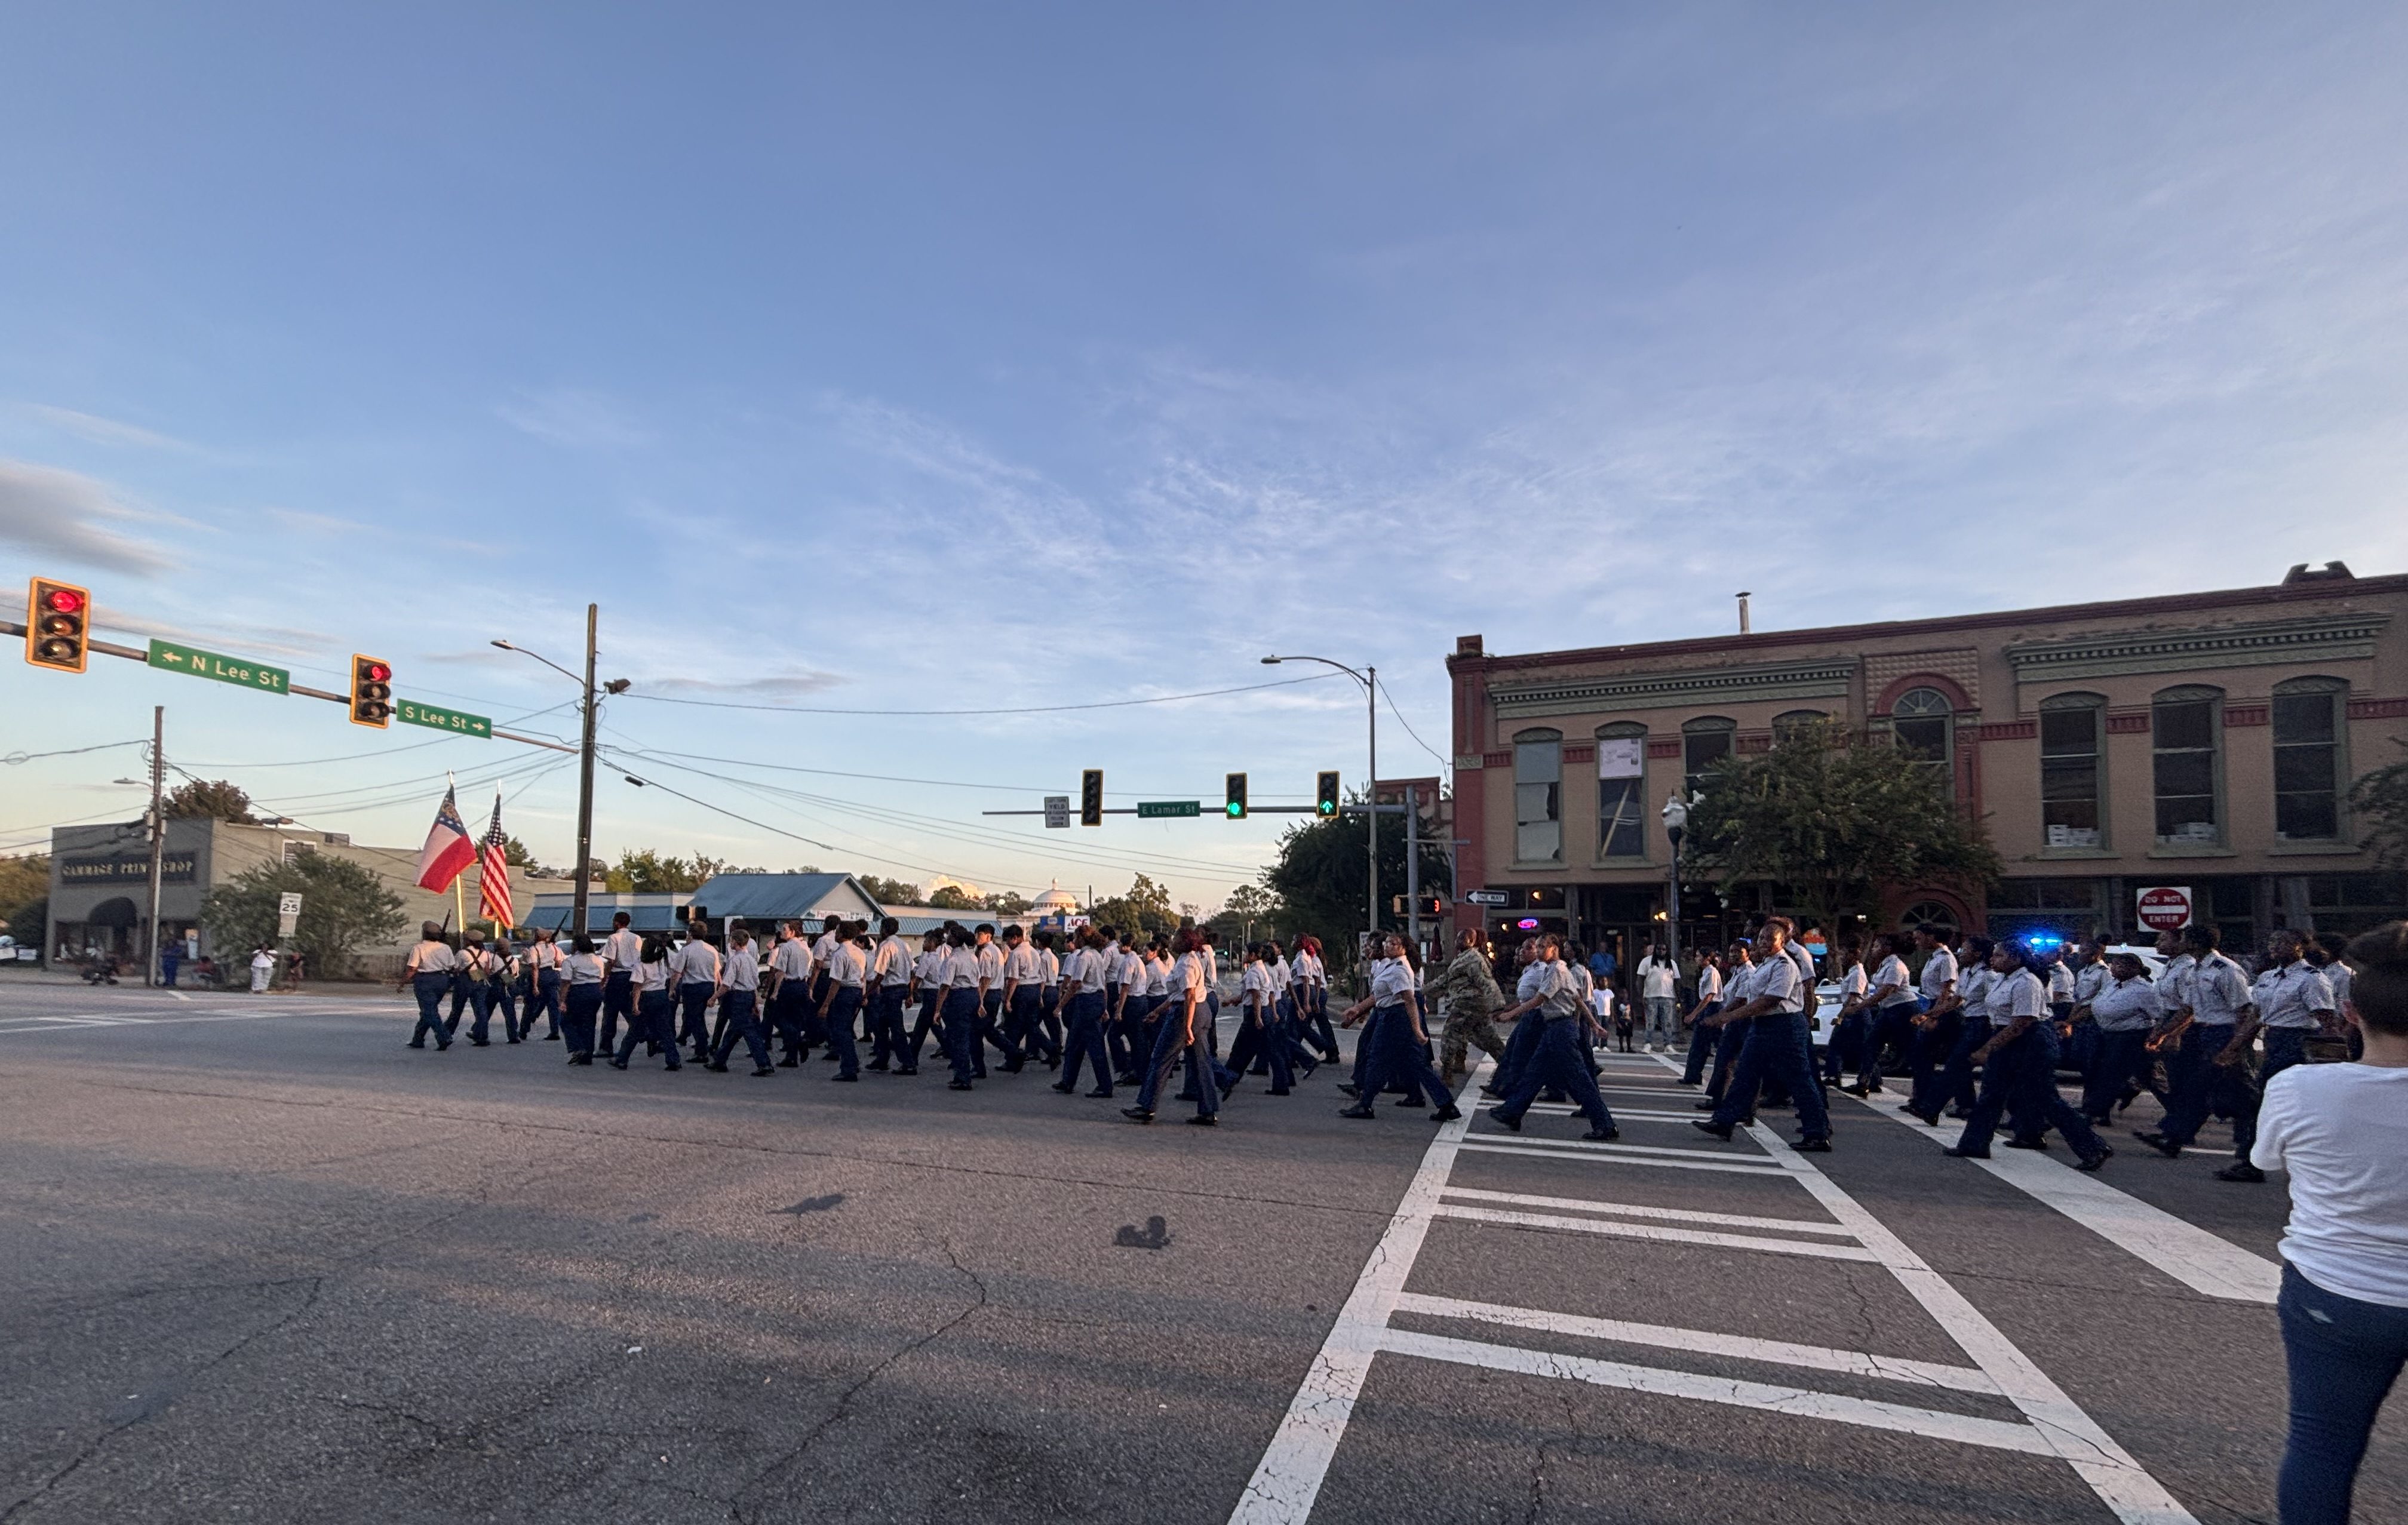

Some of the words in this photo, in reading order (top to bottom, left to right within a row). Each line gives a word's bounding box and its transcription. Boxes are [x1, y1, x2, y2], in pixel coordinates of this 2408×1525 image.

[192, 656, 206, 671] N
[216, 660, 250, 680] Lee
[259, 671, 280, 687] St
[405, 706, 414, 718] S
[420, 709, 445, 725] Lee
[452, 716, 466, 730] St
[1142, 806, 1148, 814] E
[1151, 806, 1180, 814] Lamar
[1185, 805, 1195, 814] St
[282, 903, 298, 912] 25
[2149, 915, 2179, 924] ENTER
